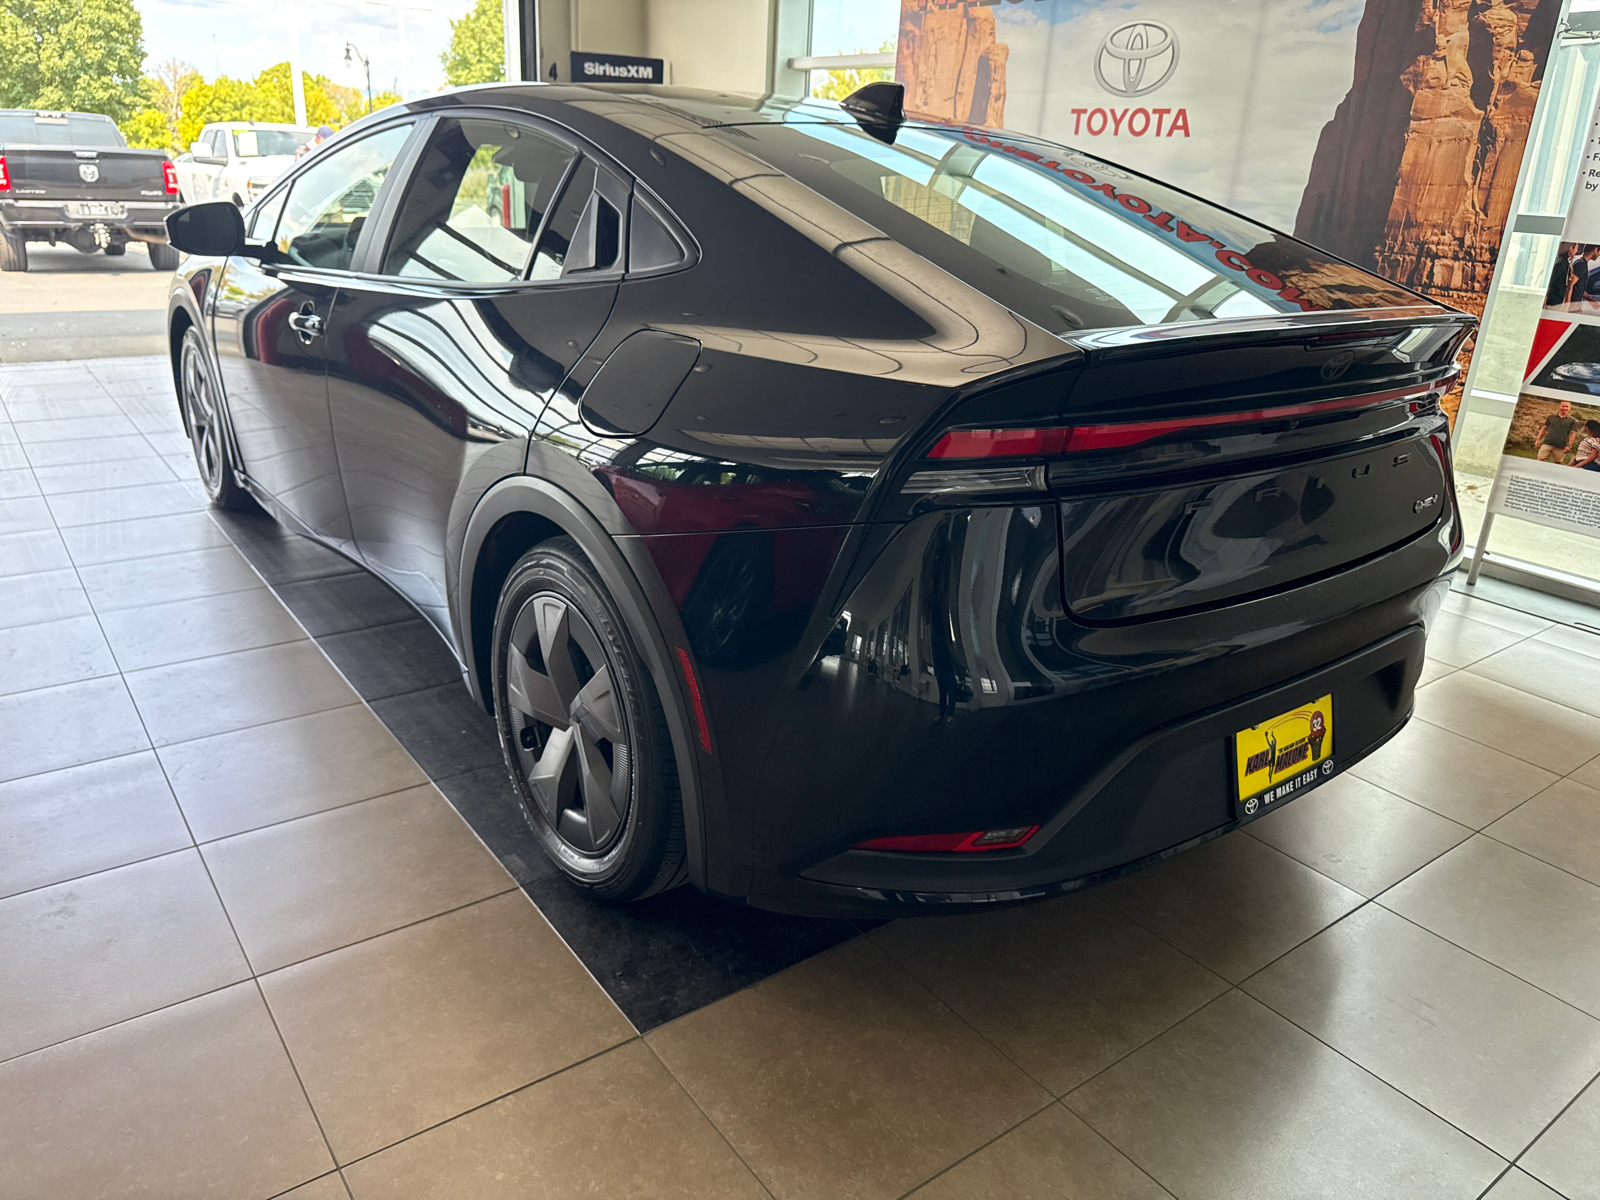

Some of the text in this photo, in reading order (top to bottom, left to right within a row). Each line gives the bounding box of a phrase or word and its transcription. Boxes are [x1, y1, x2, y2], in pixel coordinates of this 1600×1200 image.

[549, 62, 558, 81] 4
[583, 61, 653, 79] SiriusXM
[1070, 107, 1191, 138] TOYOTA
[1585, 181, 1598, 191] by
[1312, 717, 1322, 732] 32
[1244, 747, 1271, 777] KARL
[1274, 741, 1309, 775] MALONE
[1263, 768, 1318, 805] WE MAKE IT EASY
